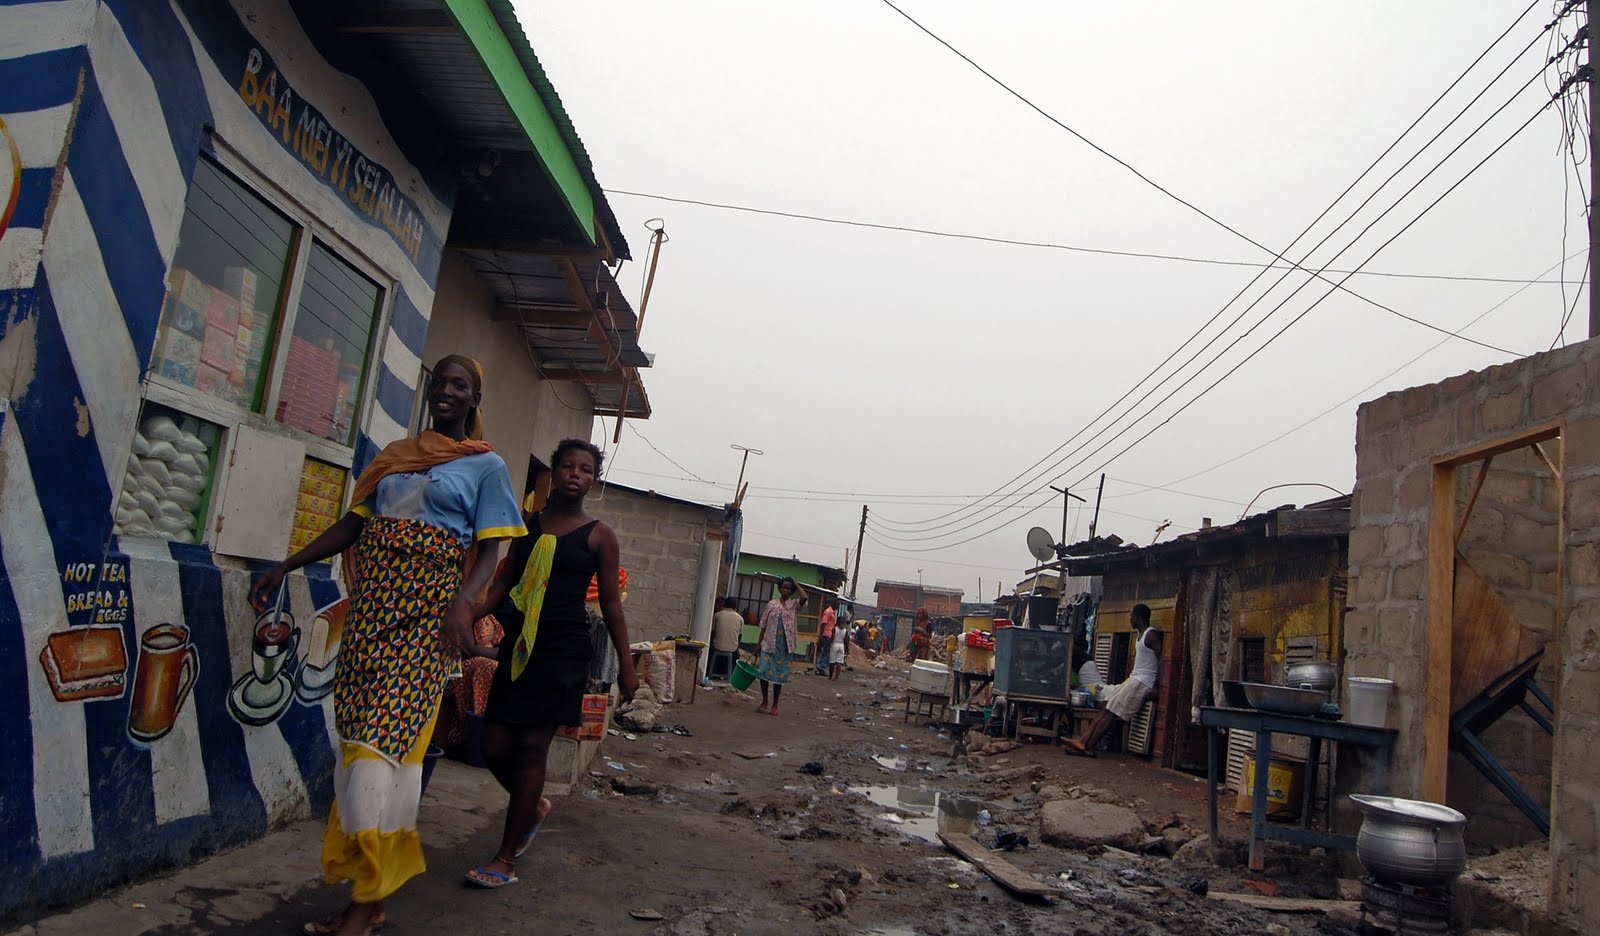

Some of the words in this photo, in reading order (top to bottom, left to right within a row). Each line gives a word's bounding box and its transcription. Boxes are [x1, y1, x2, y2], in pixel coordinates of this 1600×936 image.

[239, 47, 291, 144] BAA
[293, 104, 333, 176] MEI
[330, 135, 353, 192] YI
[374, 181, 424, 264] ALLAH
[64, 562, 96, 583] HOT
[102, 562, 127, 583] TEA
[66, 590, 113, 614] BREAD
[117, 589, 128, 608] &
[96, 608, 127, 623] EGGS
